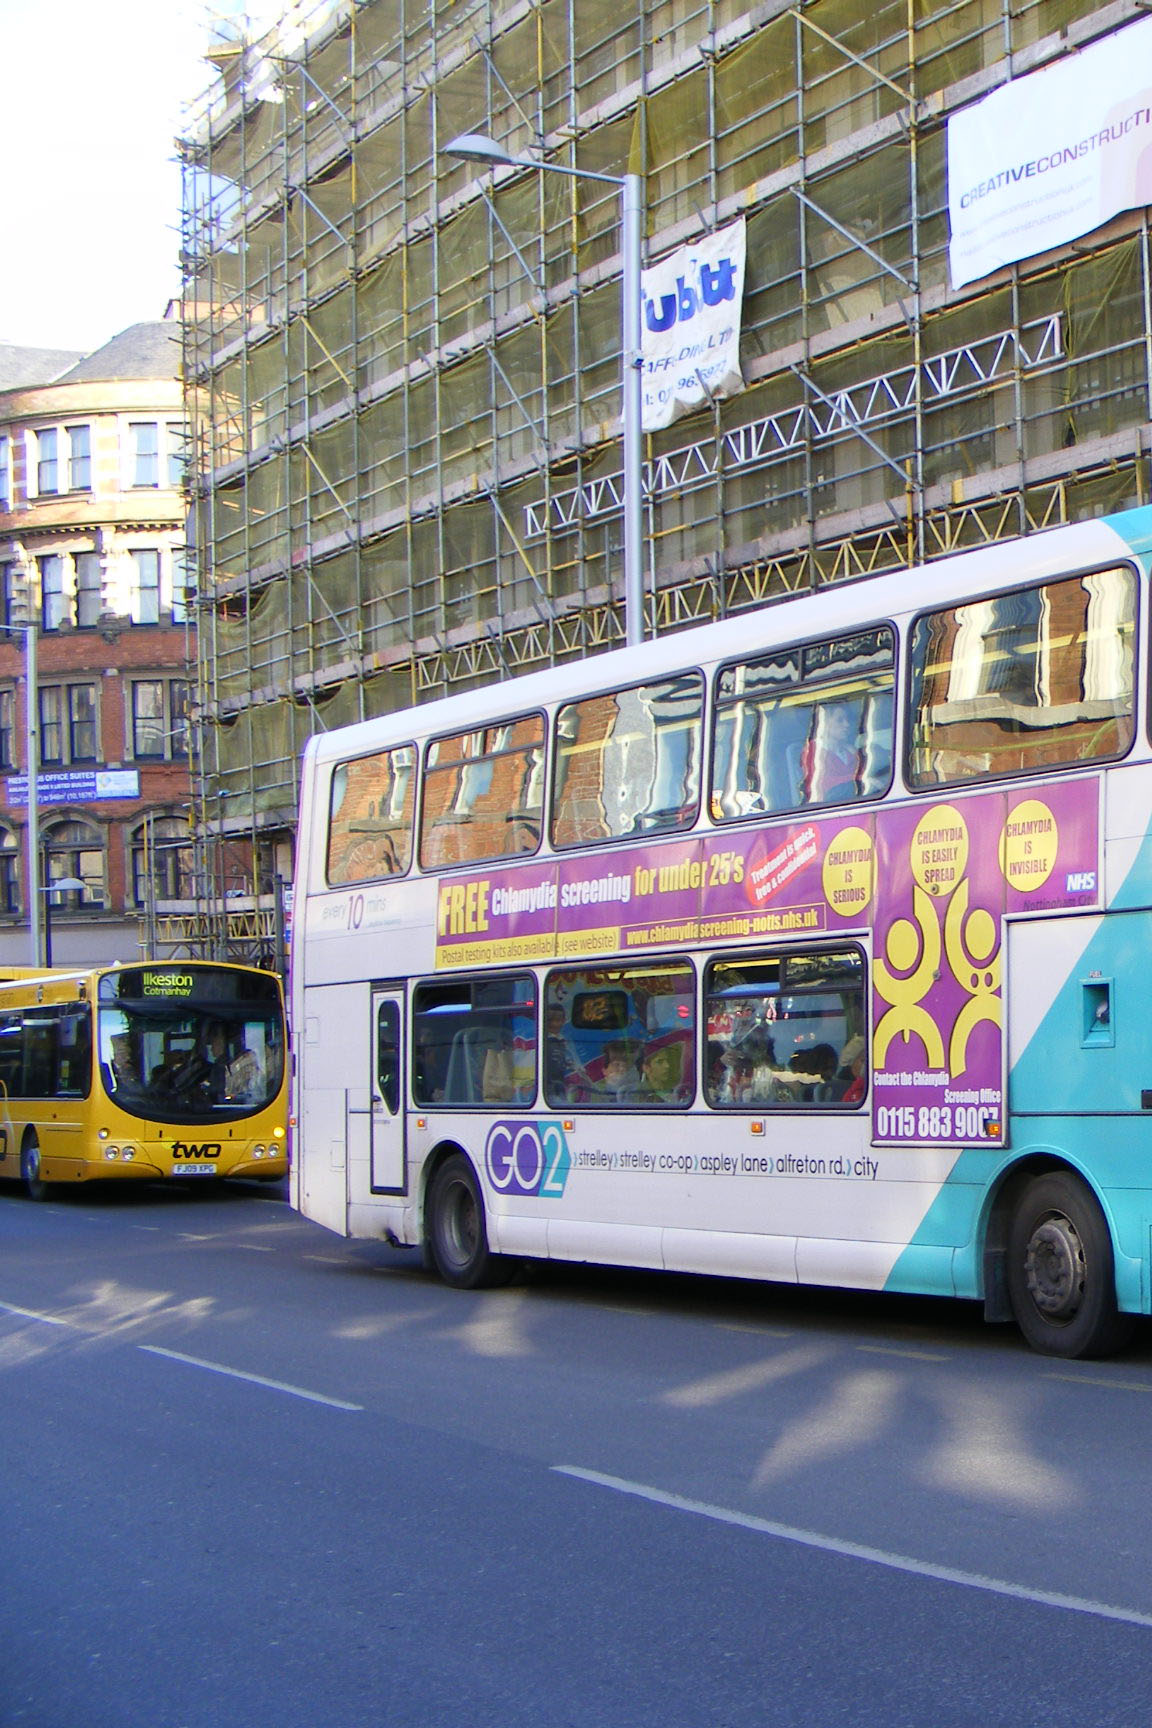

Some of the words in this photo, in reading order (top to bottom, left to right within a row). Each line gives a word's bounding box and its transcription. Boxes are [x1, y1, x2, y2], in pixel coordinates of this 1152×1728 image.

[46, 773, 68, 782] OFFICE
[917, 827, 963, 844] CHLAMYDIA
[1006, 818, 1051, 836] CHLAMYDIA
[921, 852, 930, 864] IS
[932, 847, 959, 862] EASILY
[1024, 841, 1032, 854] IS
[828, 849, 872, 865] CHLAMYDIA
[924, 867, 955, 883] SPREAD
[1009, 859, 1047, 876] INVISIBLE
[845, 871, 853, 883] IS
[1067, 872, 1095, 891] NHS
[439, 880, 490, 937] FREE
[491, 880, 557, 917] Chlamydia
[561, 872, 631, 907] screening
[635, 866, 656, 896] for
[659, 858, 708, 893] under
[709, 851, 745, 886] 25's
[755, 881, 772, 901] free
[833, 887, 865, 903] SERIOUS
[322, 903, 347, 921] every
[348, 894, 364, 930] 10
[627, 908, 818, 946] www.chlamydiascreening-notts.nhs.uk
[442, 946, 464, 963] Postal
[465, 943, 491, 963] testing
[493, 942, 506, 958] kits
[507, 941, 521, 956] also
[522, 938, 559, 955] available
[561, 937, 578, 953] (see
[580, 931, 616, 952] website)
[143, 972, 193, 986] Ilkeston
[143, 986, 192, 996] Cotmanhay
[873, 1071, 899, 1086] Contact
[900, 1071, 912, 1085] the
[913, 1071, 949, 1087] Chlamydia
[944, 1089, 979, 1105] Screening
[980, 1088, 1001, 1104] Office
[878, 1106, 915, 1137] 0115
[918, 1106, 951, 1137] 883
[171, 1141, 221, 1159] two
[486, 1125, 564, 1192] GO2
[176, 1164, 197, 1173] FJ09
[578, 1150, 613, 1172] strelley
[620, 1152, 656, 1173] strelley
[658, 1155, 693, 1173] co-op
[700, 1154, 737, 1176] aspley
[741, 1153, 767, 1173] lane
[775, 1153, 826, 1175] alfreton
[854, 1156, 878, 1180] city
